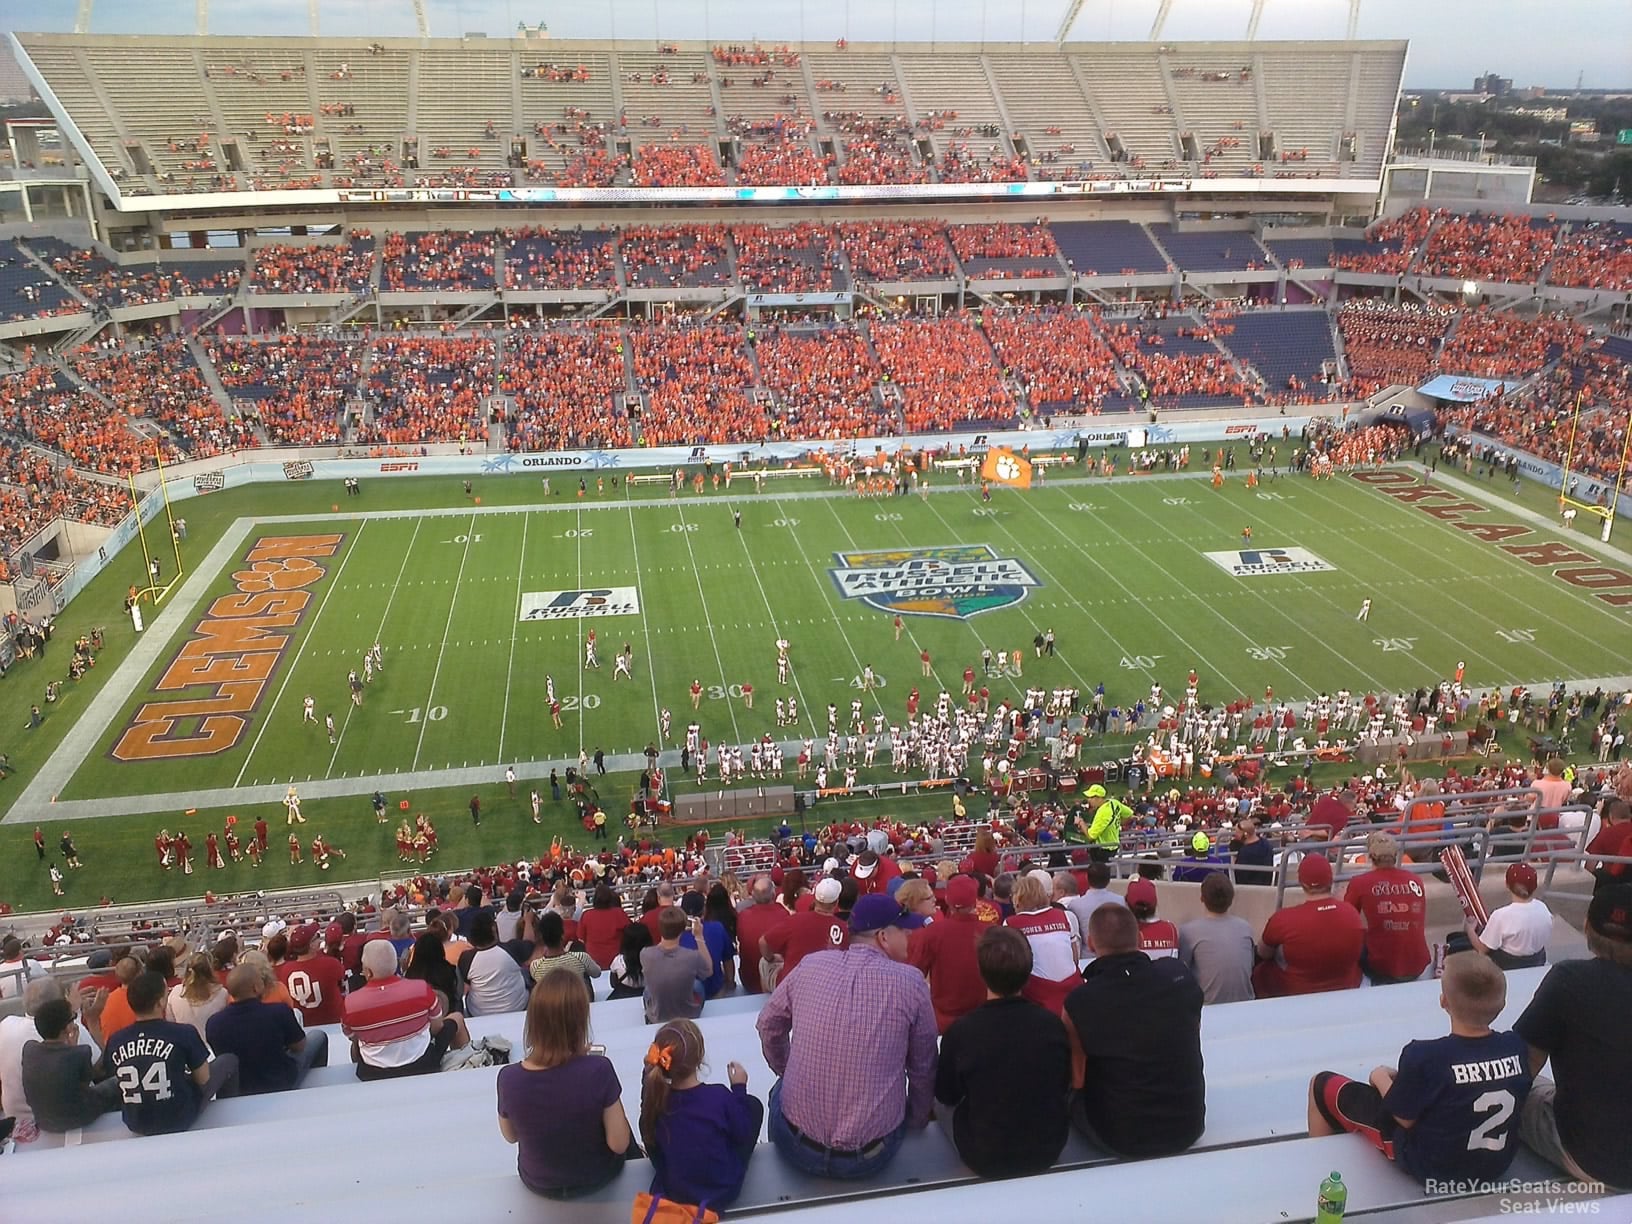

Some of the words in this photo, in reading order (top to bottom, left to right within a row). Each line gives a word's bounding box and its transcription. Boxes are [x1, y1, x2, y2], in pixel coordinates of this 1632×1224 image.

[1225, 425, 1258, 434] ESPN
[380, 462, 419, 472] ESPN
[522, 457, 582, 467] ORLANDO
[1348, 470, 1632, 608] OKLAHO
[844, 564, 1017, 582] RUSSELL
[1233, 561, 1326, 571] RUSSELL
[894, 585, 995, 598] BOWL
[529, 603, 635, 615] RUSSELL
[1245, 646, 1288, 661] 30
[1372, 638, 1413, 653] 20
[1119, 654, 1155, 670] 40
[707, 684, 746, 699] 30
[560, 694, 601, 711] 20
[404, 706, 448, 723] 10
[288, 971, 323, 1009] OU
[112, 1039, 174, 1066] CABRERA
[1452, 1055, 1523, 1085] BRYDEN
[117, 1061, 172, 1103] 24
[1467, 1089, 1516, 1151] 2
